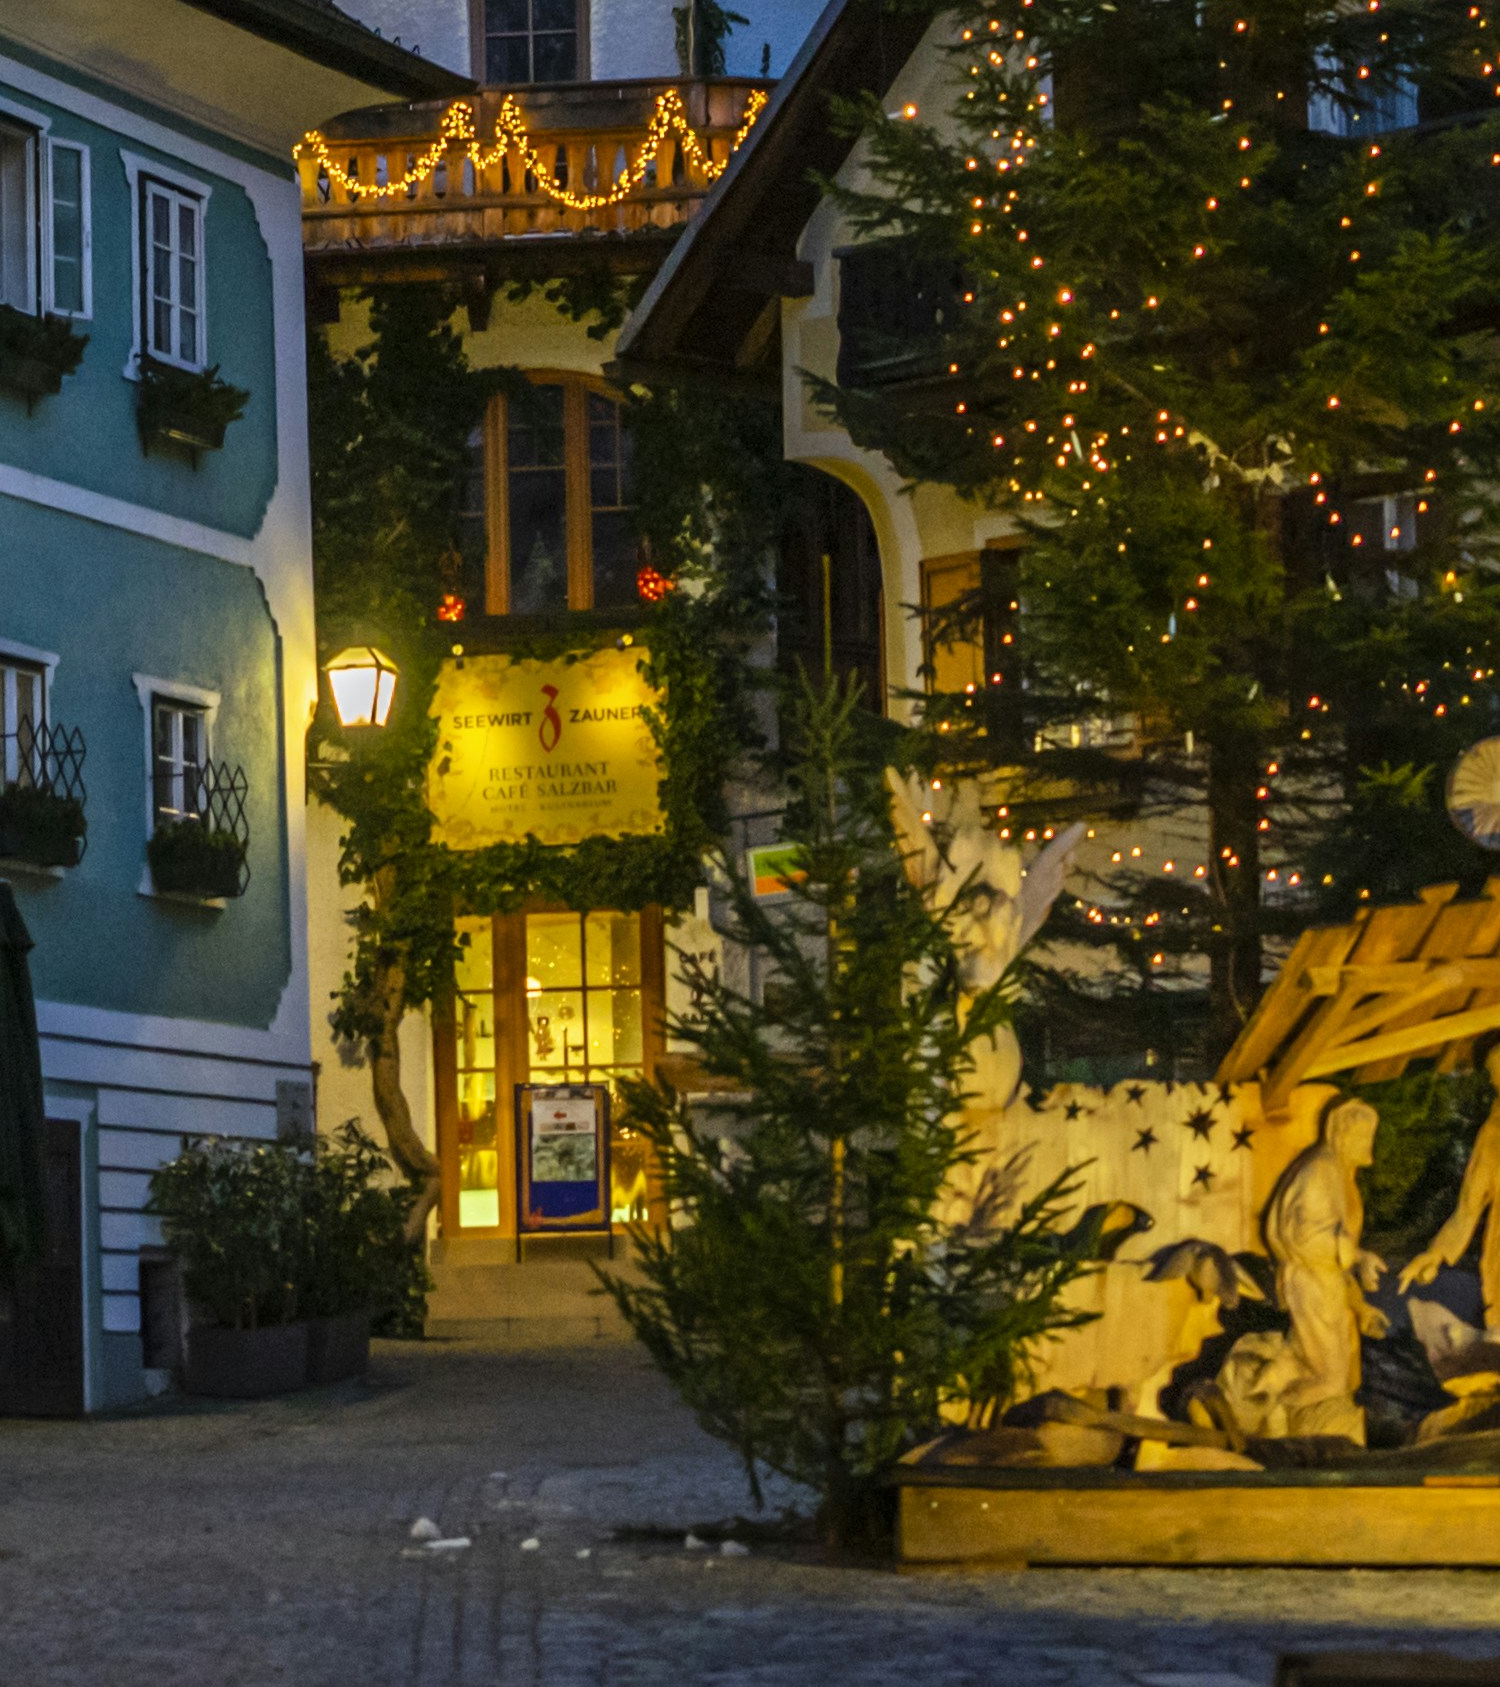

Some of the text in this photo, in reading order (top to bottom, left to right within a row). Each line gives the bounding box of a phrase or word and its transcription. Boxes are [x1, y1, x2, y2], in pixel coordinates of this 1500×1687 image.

[453, 705, 643, 729] SEEWIRT ZAUNER
[489, 762, 610, 782] RESTAURANT
[482, 779, 618, 801] CAFÉ SALZBAR
